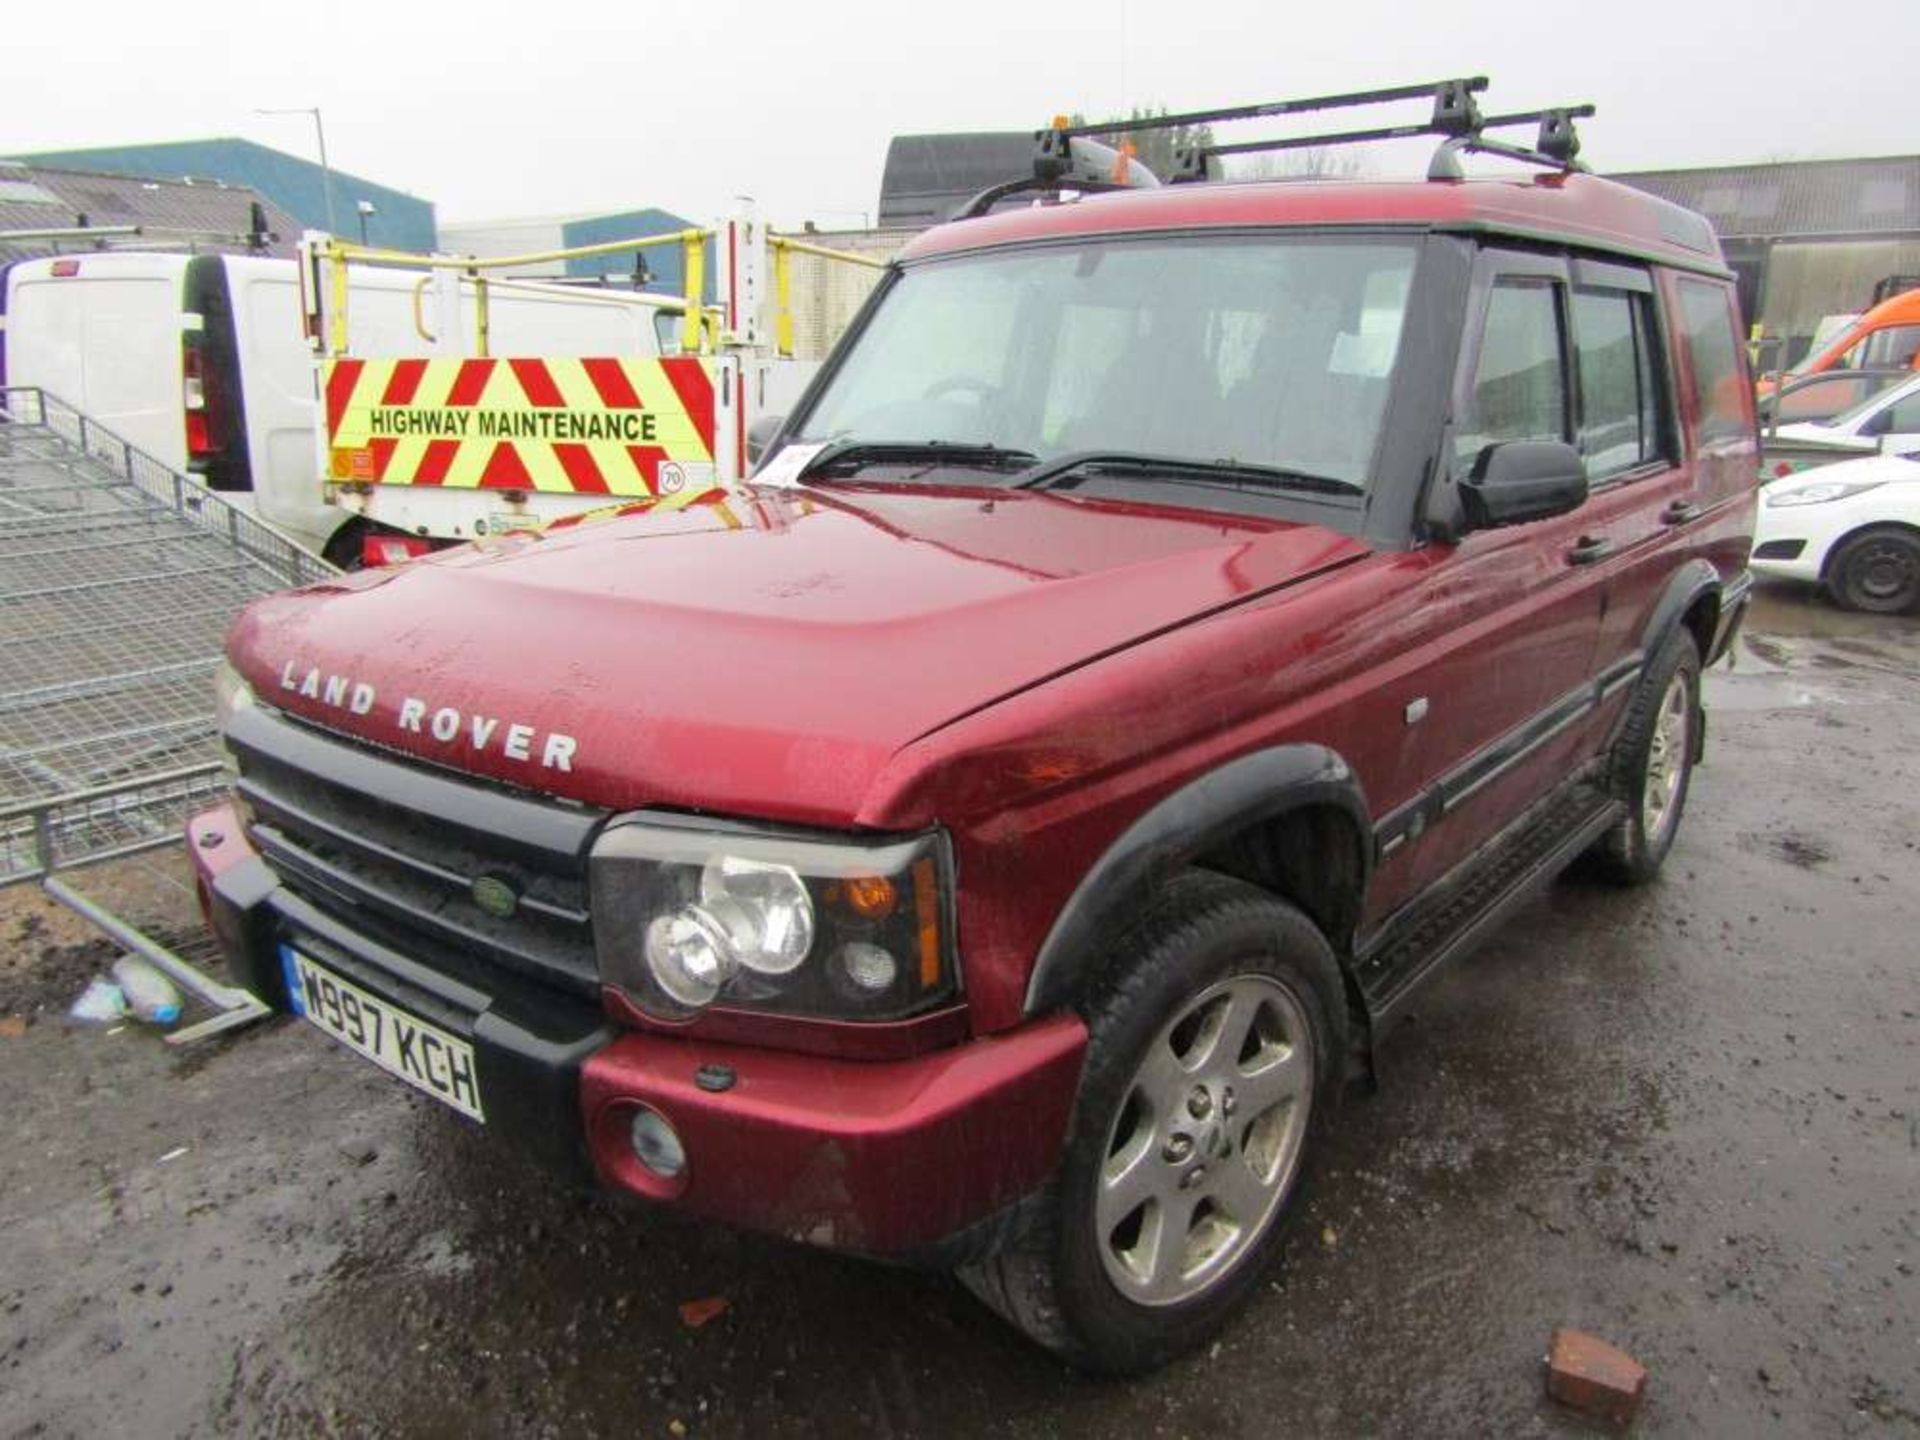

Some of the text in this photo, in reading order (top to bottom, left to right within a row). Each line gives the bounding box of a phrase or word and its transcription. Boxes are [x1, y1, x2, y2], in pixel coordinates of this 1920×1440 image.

[370, 409, 656, 440] HIGHWAY MAINTENANCE
[665, 470, 680, 485] 70
[280, 660, 578, 772] LAND ROVER
[393, 1017, 479, 1110] KCH
